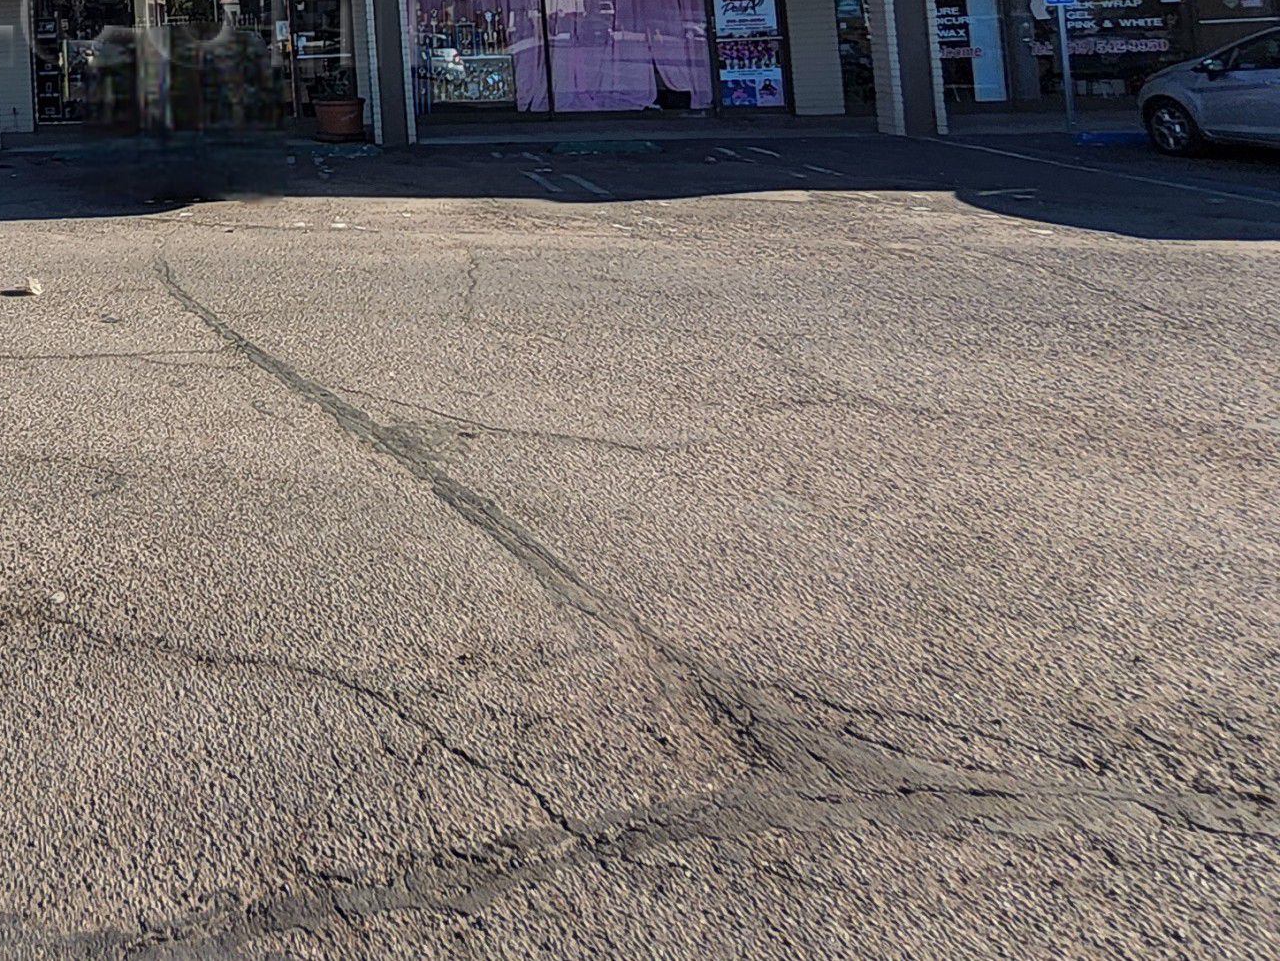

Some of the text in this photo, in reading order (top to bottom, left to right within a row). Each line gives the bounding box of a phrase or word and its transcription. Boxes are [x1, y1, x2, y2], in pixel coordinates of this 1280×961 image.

[1102, 0, 1142, 8] WRAP
[1066, 11, 1093, 20] GEL
[1067, 18, 1163, 29] PINK & WHITE
